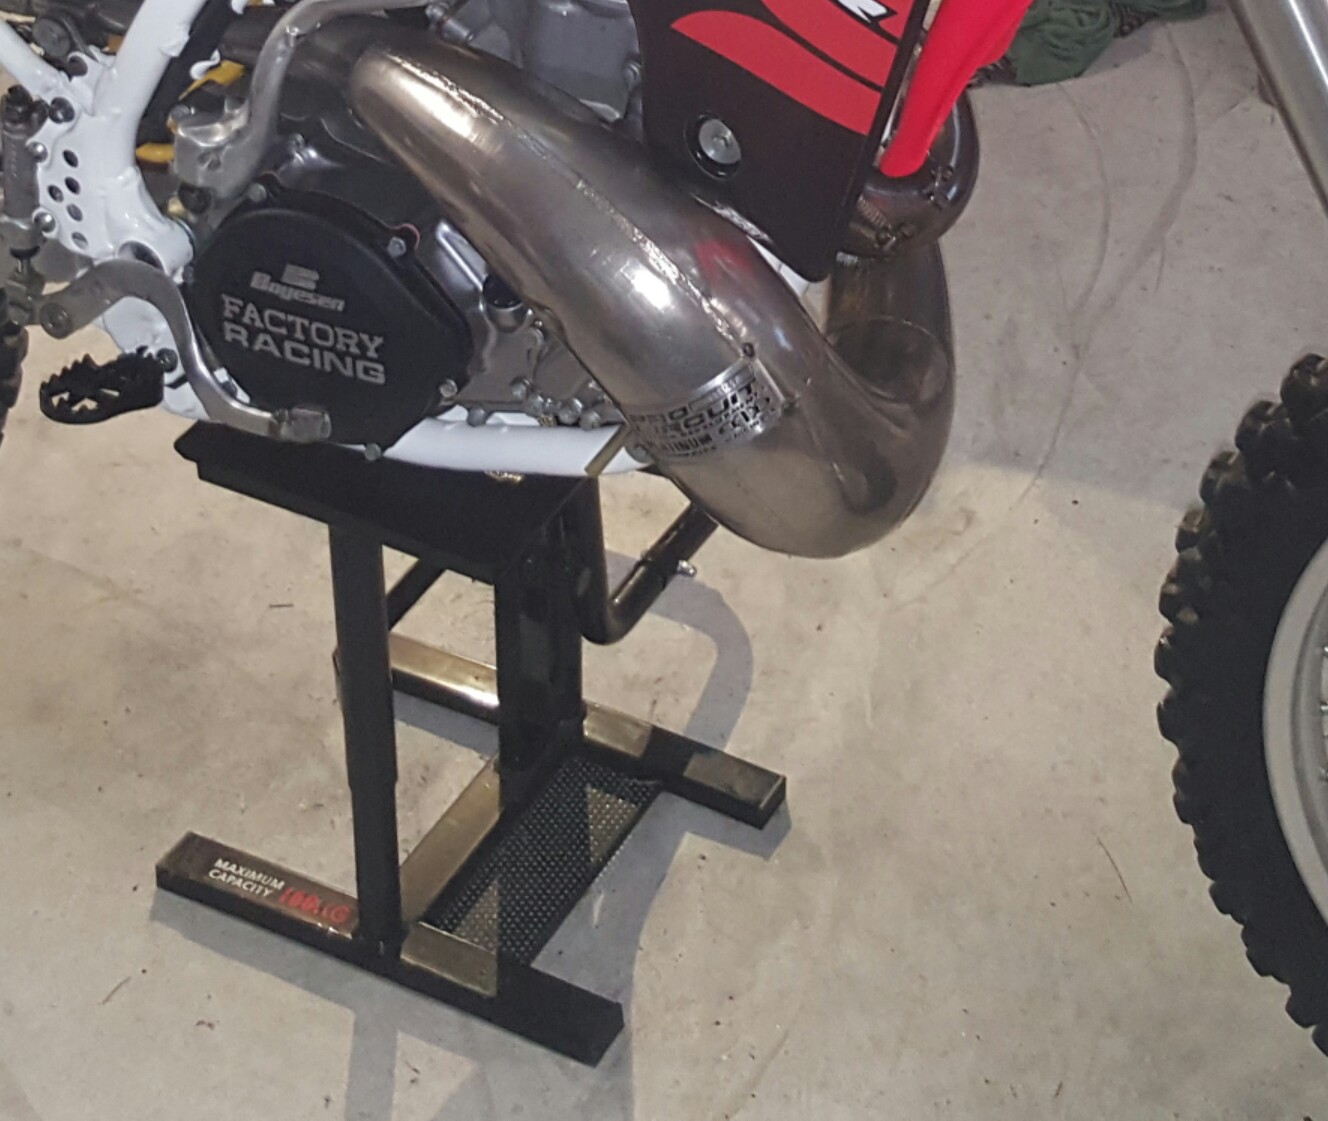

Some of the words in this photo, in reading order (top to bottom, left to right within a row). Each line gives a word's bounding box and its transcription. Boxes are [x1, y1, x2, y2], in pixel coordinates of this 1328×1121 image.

[249, 270, 346, 312] Boyesen
[221, 293, 385, 360] FACTORY
[222, 320, 386, 386] RACING
[208, 868, 274, 898] CAPACITY
[213, 858, 286, 891] MAXIMUM
